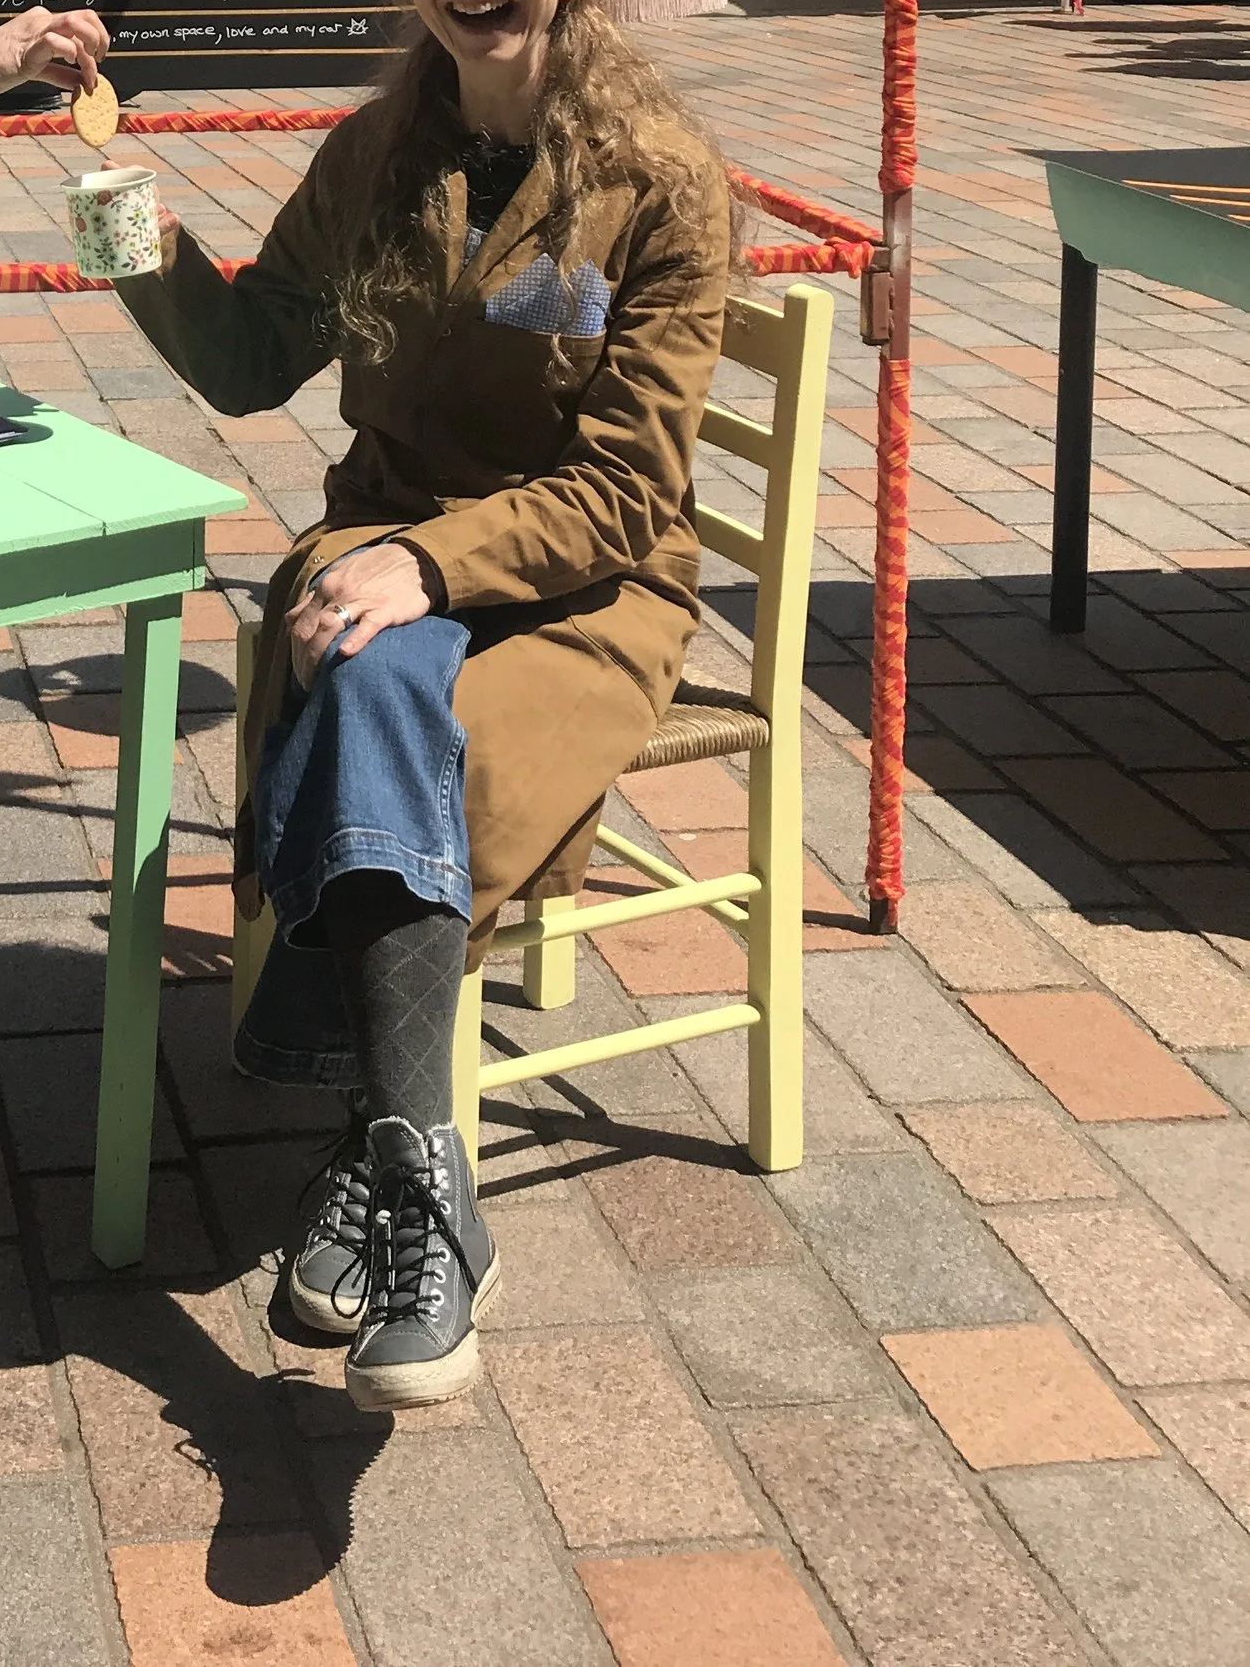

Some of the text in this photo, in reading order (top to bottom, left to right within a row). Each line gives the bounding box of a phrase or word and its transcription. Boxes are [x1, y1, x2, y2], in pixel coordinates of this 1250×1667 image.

[140, 28, 170, 41] own
[173, 25, 223, 45] space,
[226, 26, 257, 39] love
[262, 24, 289, 36] and
[295, 24, 316, 38] my
[316, 23, 343, 34] cat
